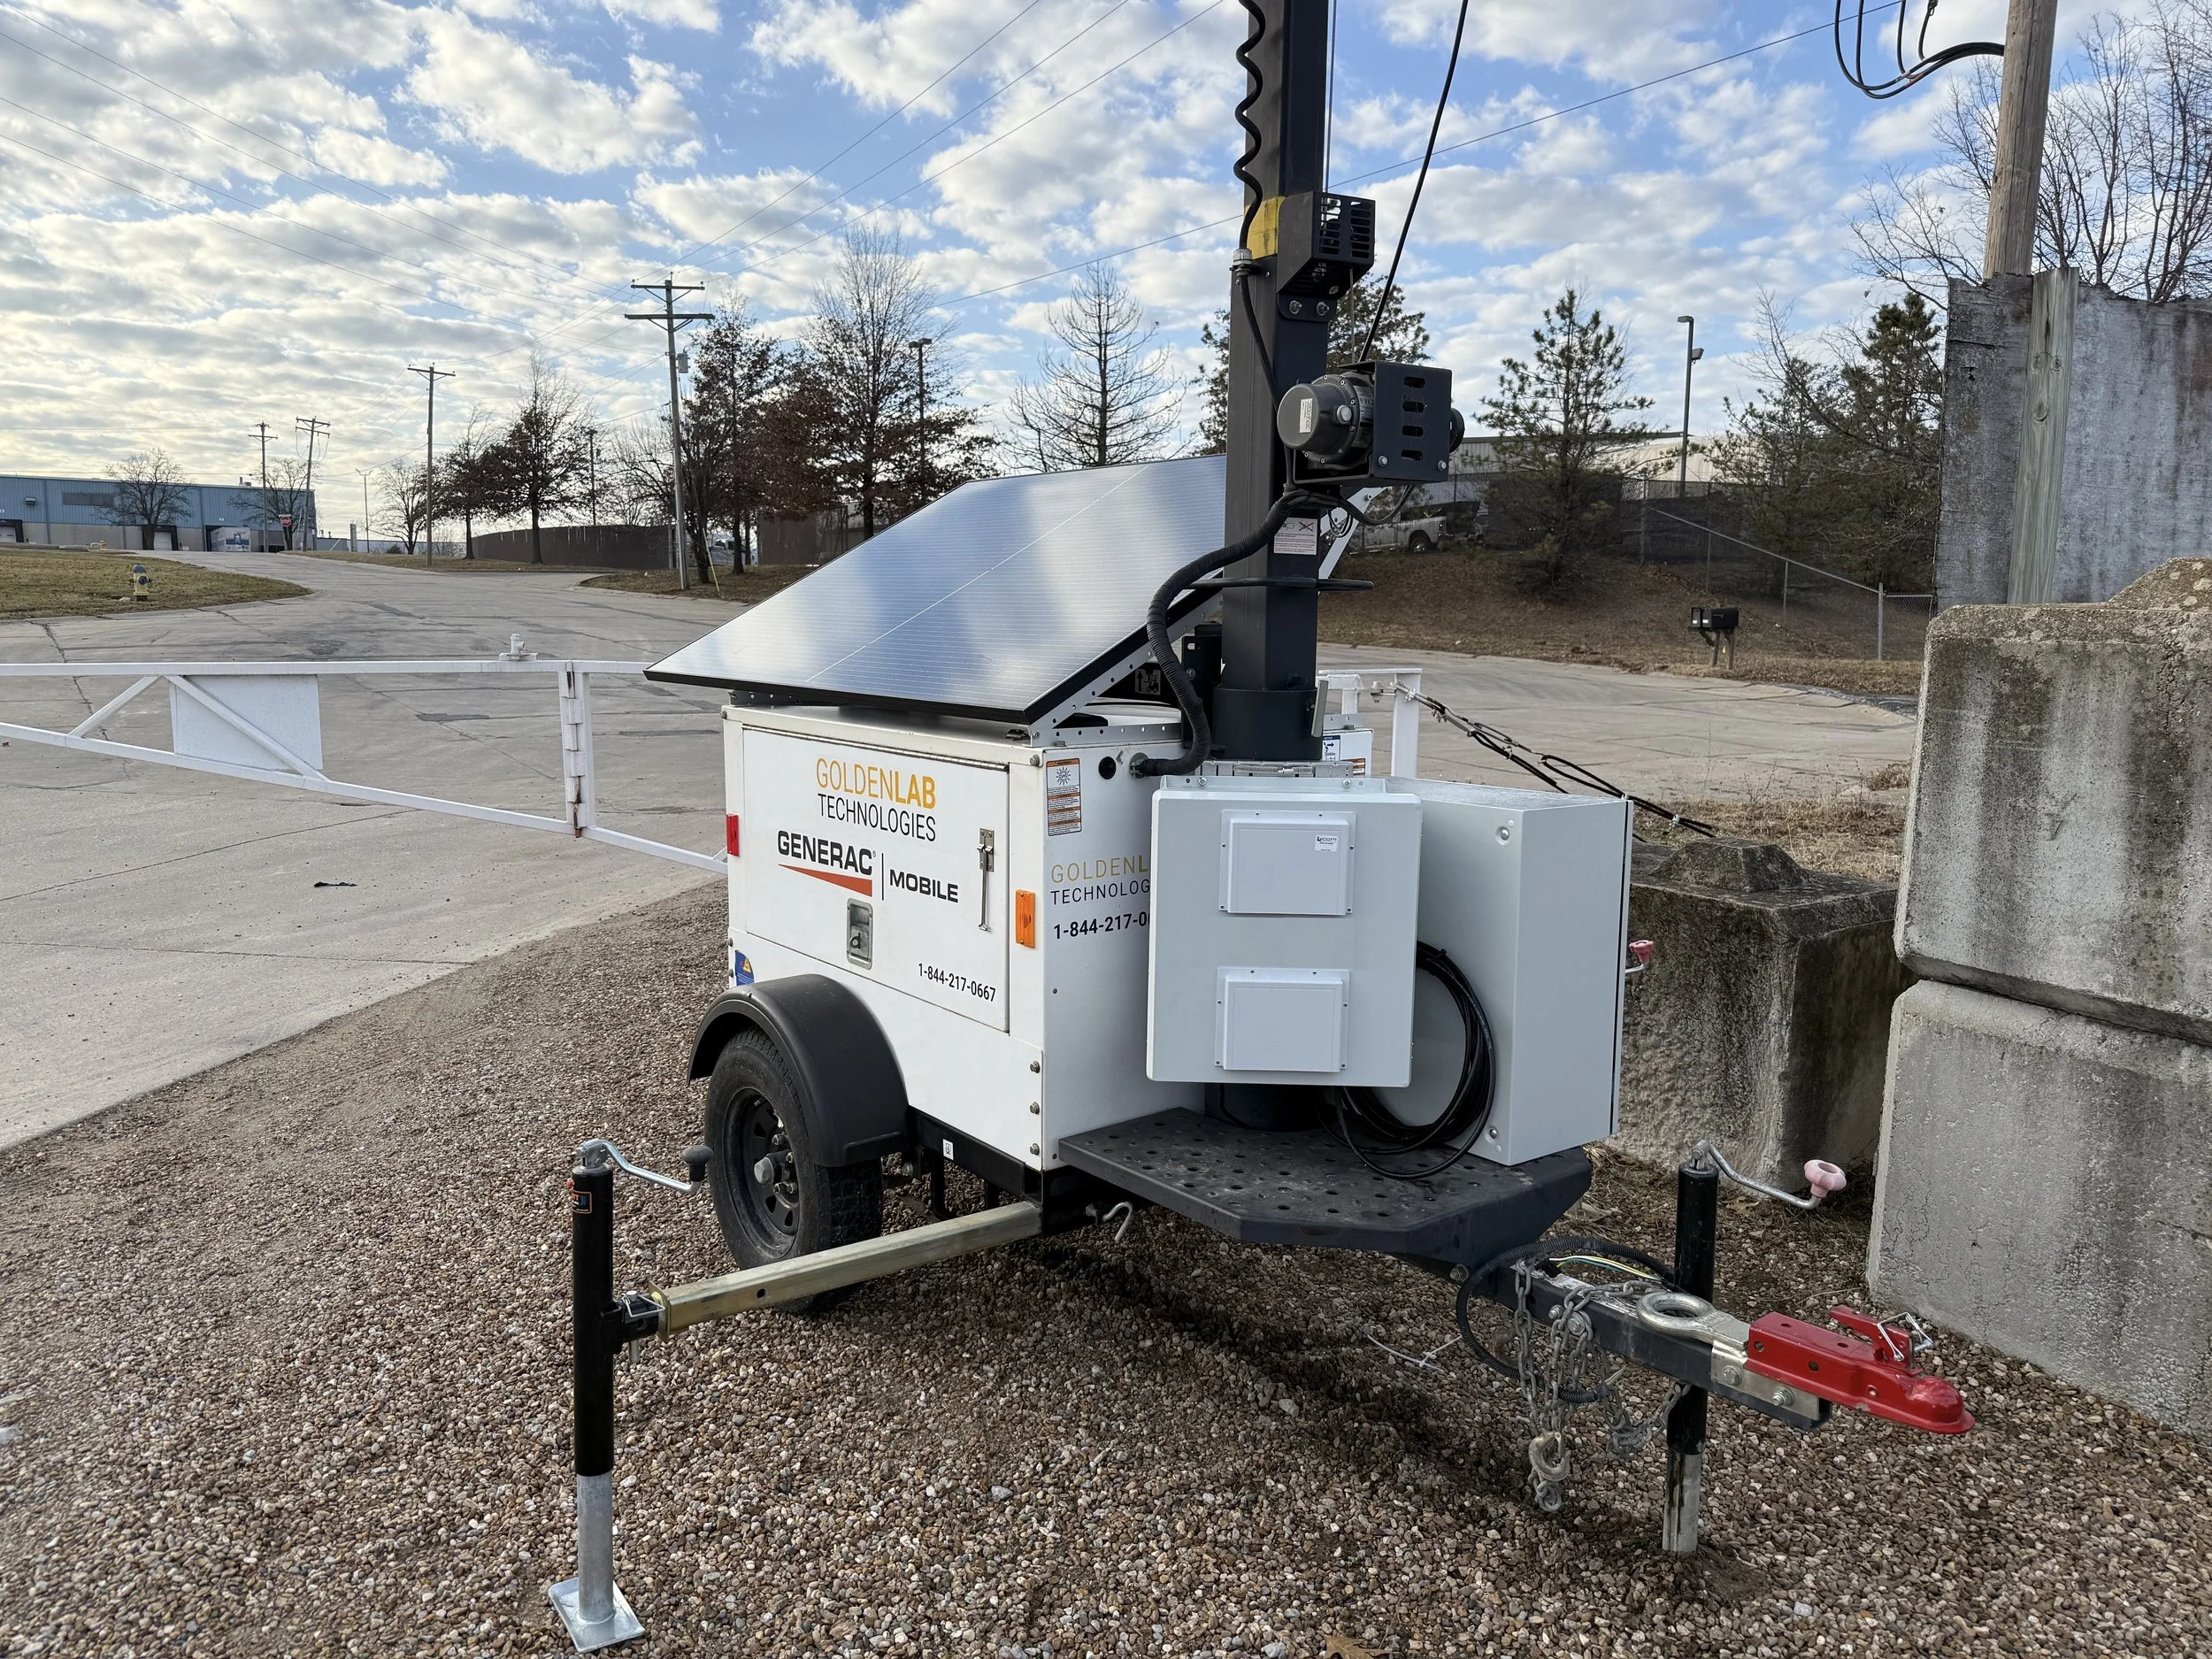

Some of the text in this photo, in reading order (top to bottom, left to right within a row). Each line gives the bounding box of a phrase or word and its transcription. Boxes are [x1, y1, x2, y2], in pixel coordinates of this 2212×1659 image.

[816, 757, 936, 810] GOLDENLAB
[818, 793, 936, 841] TECHNOLOGIES
[889, 869, 959, 903] MOBILE
[1054, 911, 1150, 940] 1-844-217-0
[918, 963, 996, 1002] 1-844-217-0667
